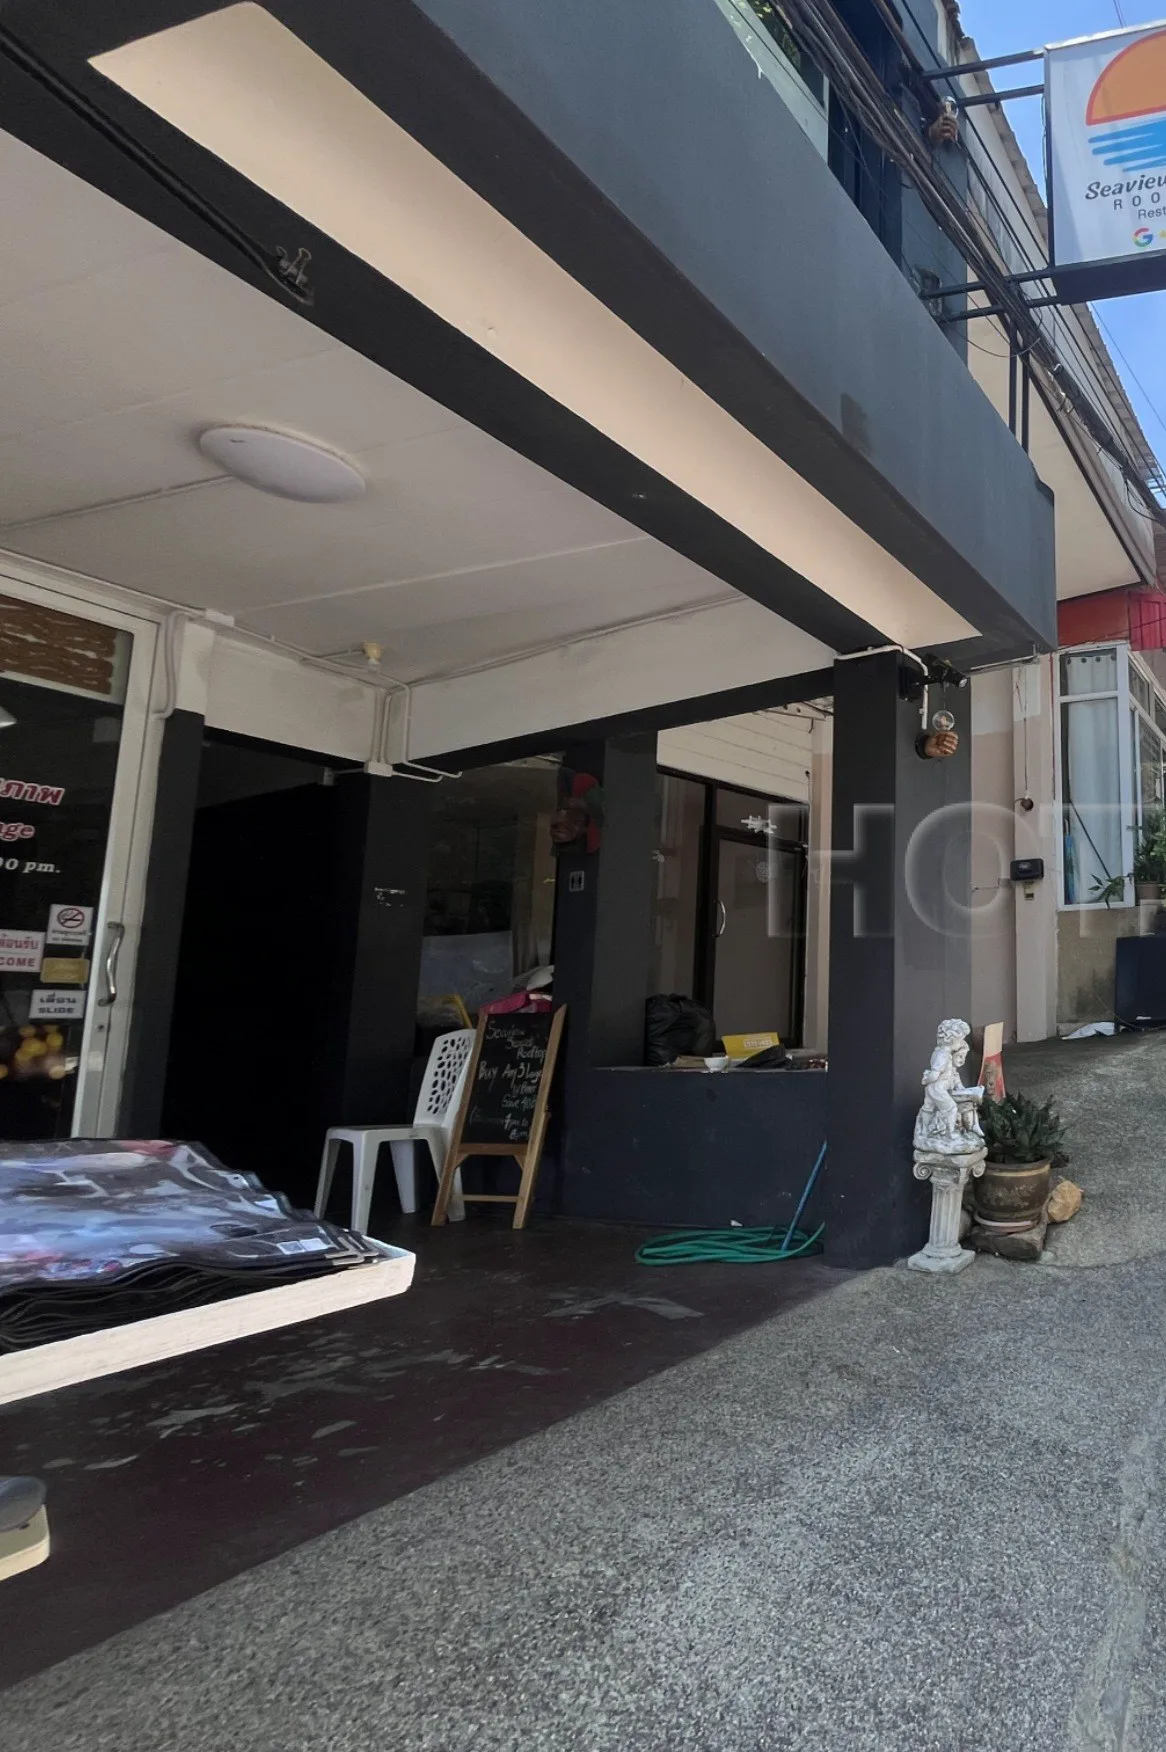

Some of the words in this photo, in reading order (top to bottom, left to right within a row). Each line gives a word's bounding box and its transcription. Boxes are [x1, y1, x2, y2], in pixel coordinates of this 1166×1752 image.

[0, 778, 65, 806] ภาพ
[22, 861, 61, 874] pm.
[478, 1060, 498, 1090] Buy
